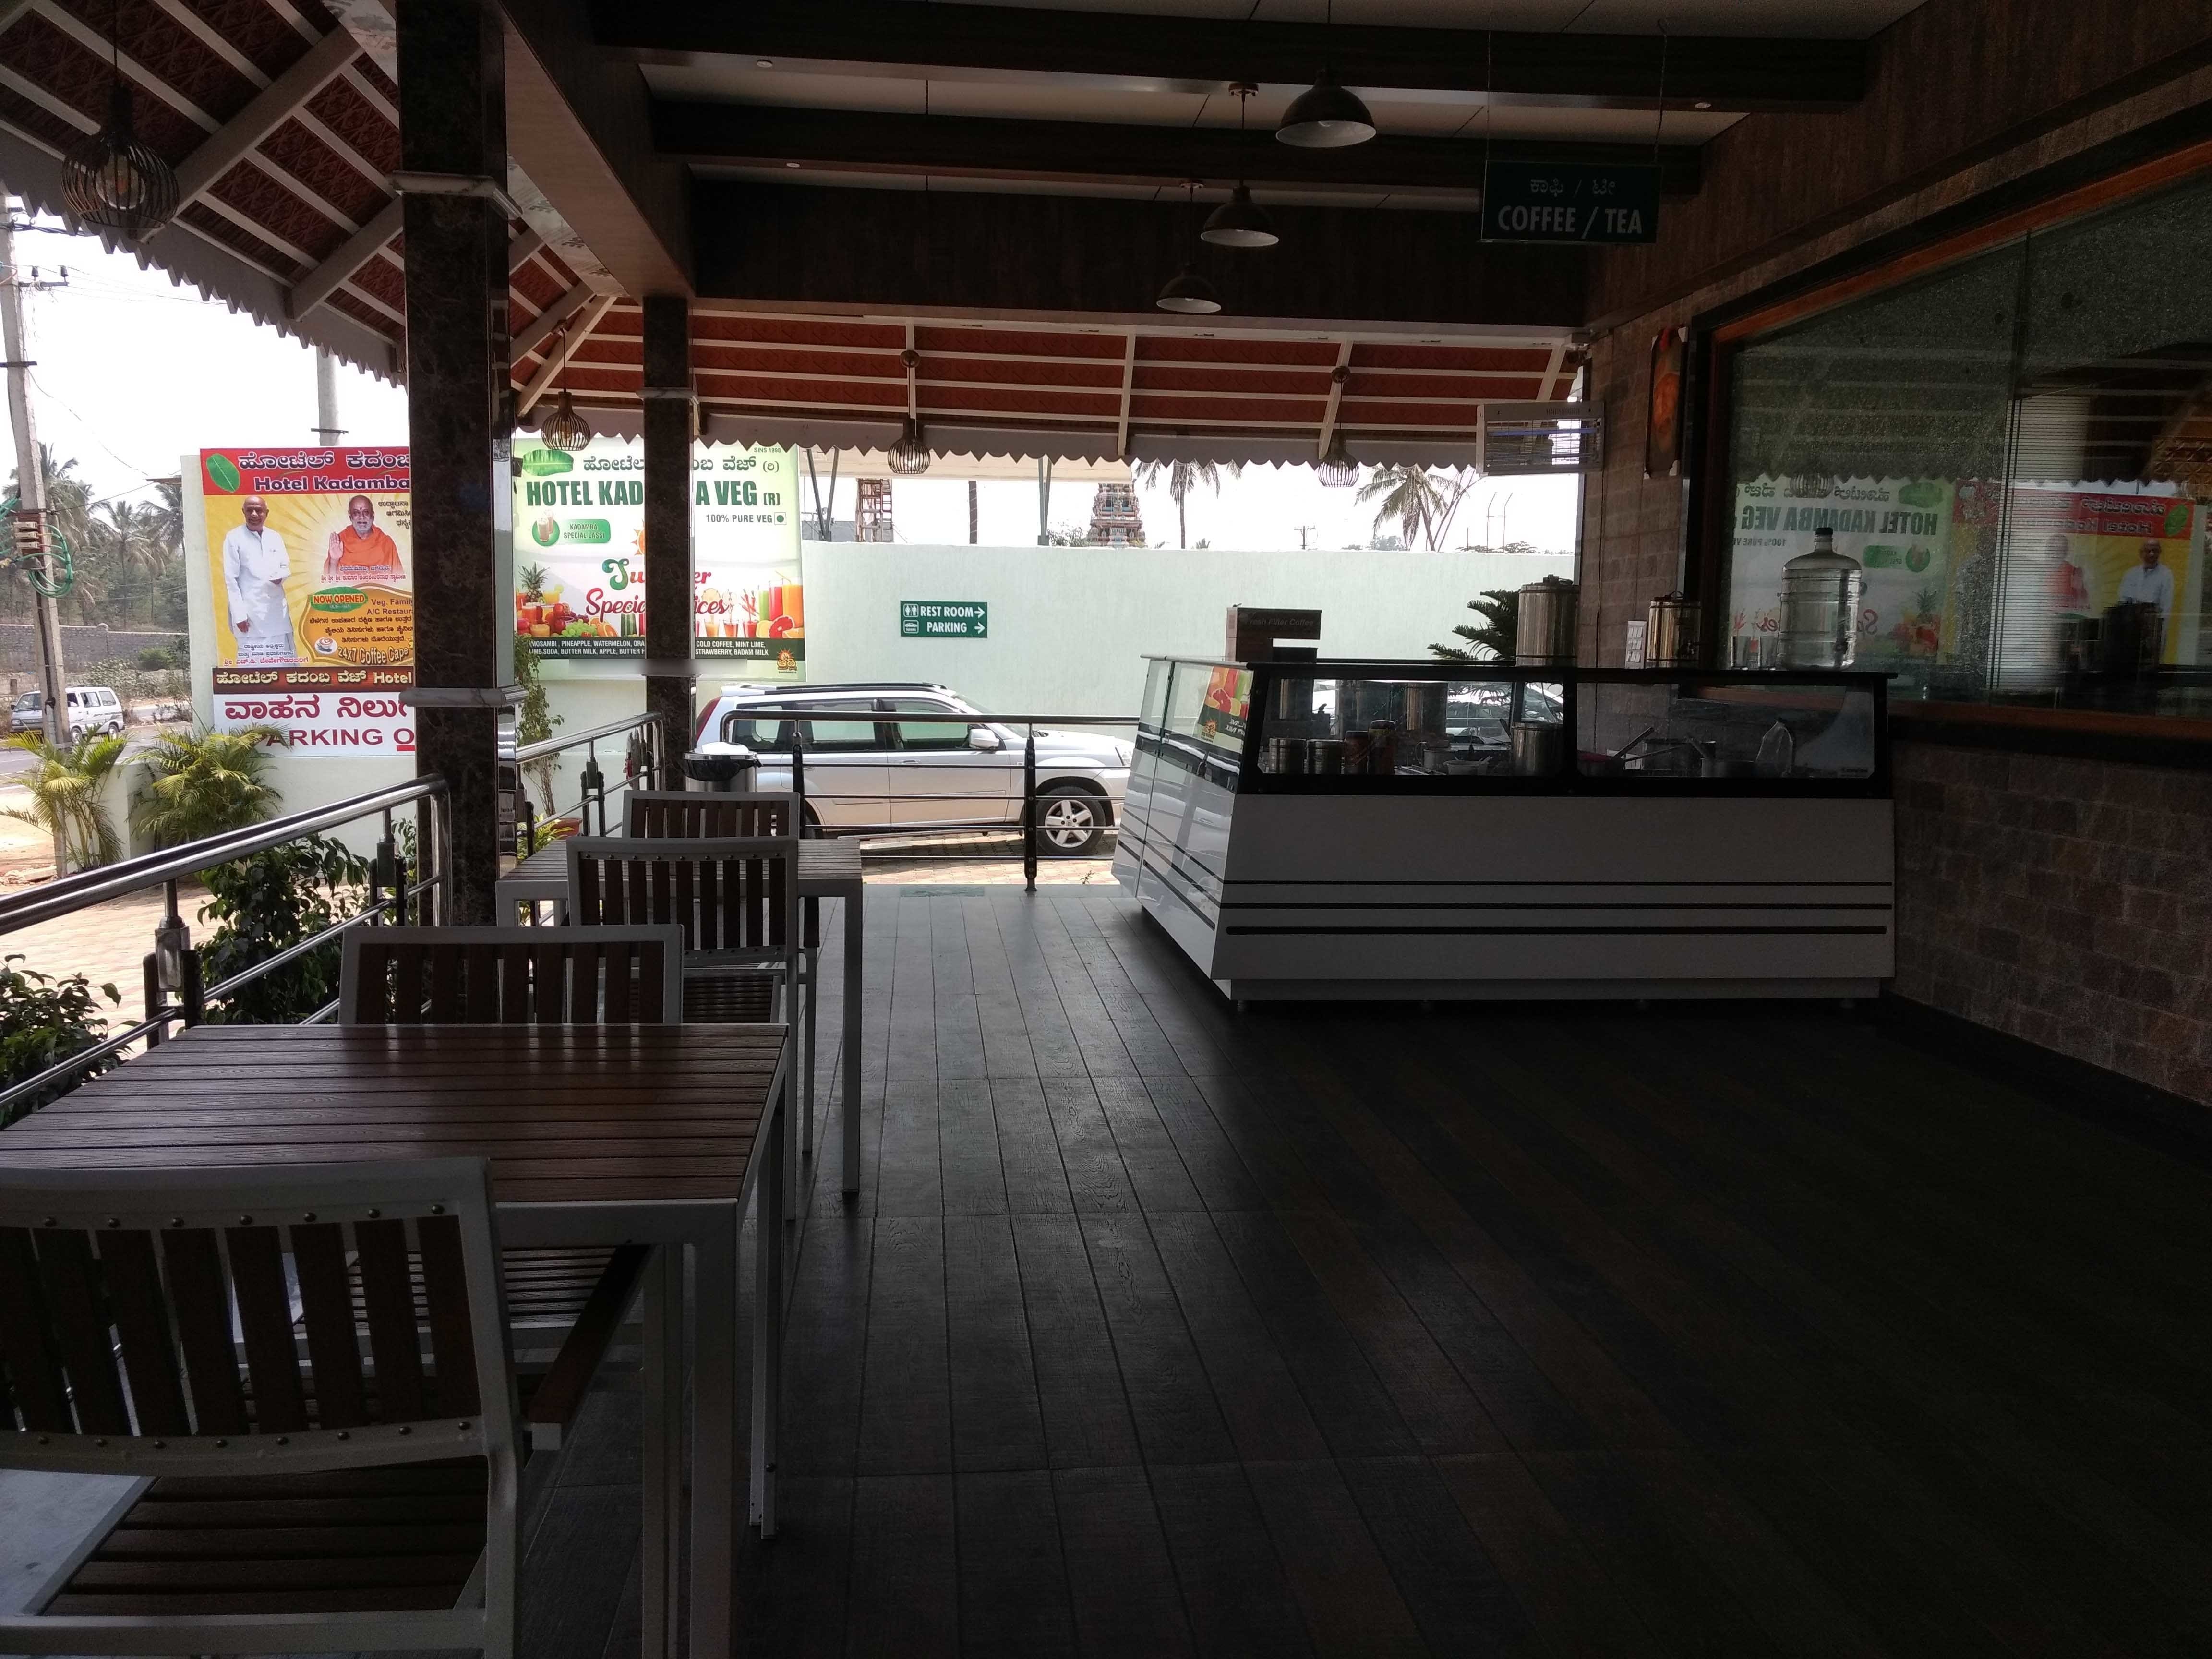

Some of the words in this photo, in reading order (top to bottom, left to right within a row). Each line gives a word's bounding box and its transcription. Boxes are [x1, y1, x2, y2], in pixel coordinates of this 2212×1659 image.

[1498, 205, 1576, 232] COFFEE
[1582, 206, 1599, 239] /
[1605, 208, 1642, 234] TEA
[238, 451, 335, 470] ಹೋಟೆಲ್
[722, 456, 757, 471] ವೆಜ್
[254, 476, 308, 492] Hotel
[314, 475, 409, 491] Kadamba
[527, 481, 593, 506] HOTEL
[714, 481, 757, 506] VEG
[763, 493, 781, 506] (R)
[706, 514, 729, 523] 100%
[732, 514, 754, 523] PURE
[756, 514, 772, 523] VEG
[313, 595, 332, 604] NOW
[334, 594, 365, 603] OPENED
[920, 606, 942, 617] REST
[944, 606, 974, 618] ROOM
[926, 622, 968, 633] PARKING
[1289, 618, 1314, 626] Coffee
[337, 646, 358, 662] 24x7
[359, 647, 387, 665] Coffee
[388, 646, 409, 662] Cape
[216, 670, 278, 684] ಹೋಟೆಲ್
[286, 670, 331, 684] ಕದಂಬ
[337, 670, 367, 684] ವೆಜ್
[373, 672, 412, 684] Hotel
[225, 694, 320, 720] ವಾಹನ
[262, 728, 383, 746] ARKING
